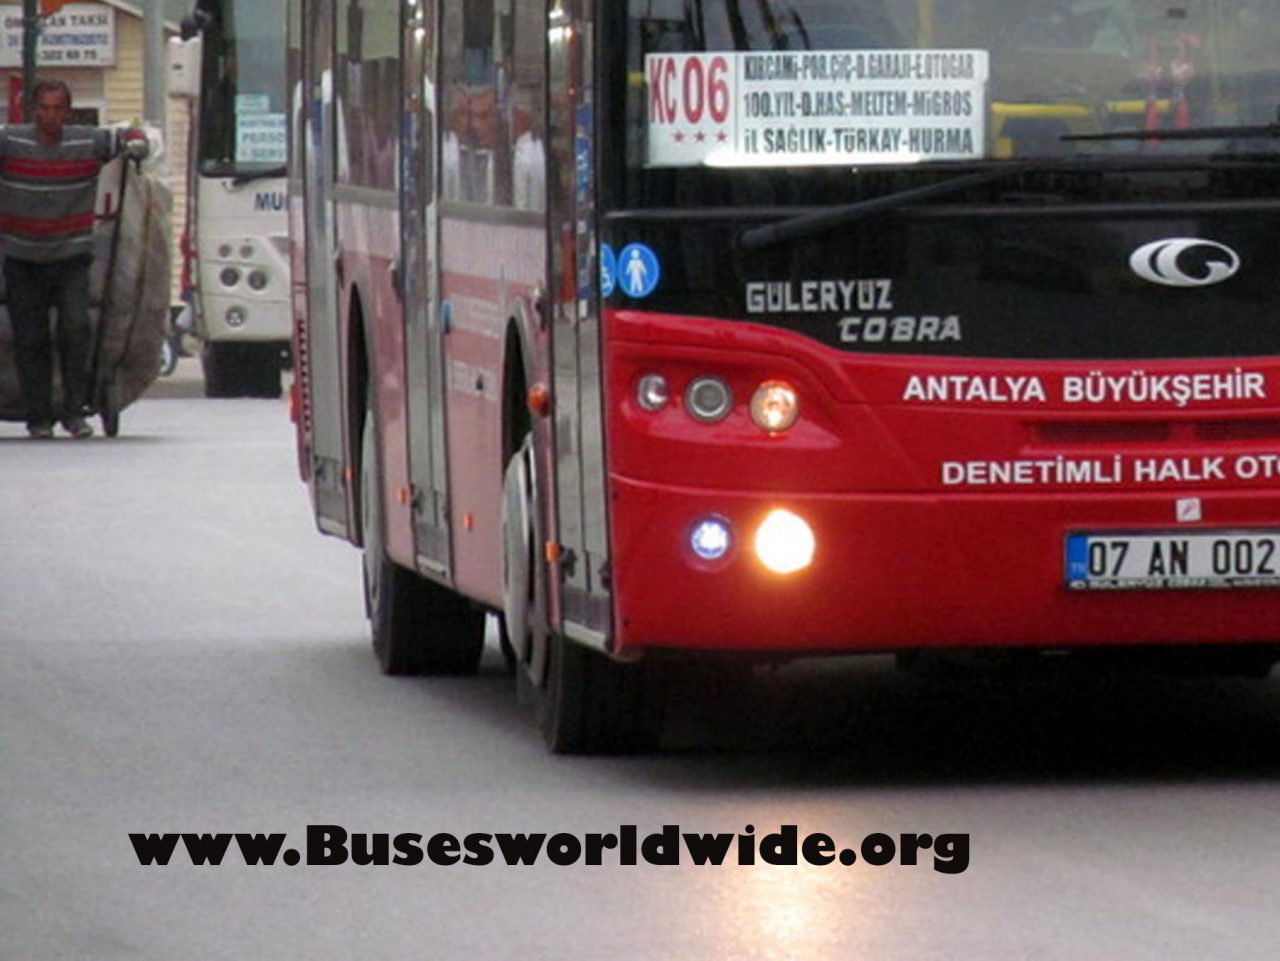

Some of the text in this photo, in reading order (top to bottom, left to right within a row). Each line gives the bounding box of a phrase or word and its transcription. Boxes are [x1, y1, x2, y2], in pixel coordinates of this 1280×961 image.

[839, 316, 962, 342] COBRA
[903, 376, 1046, 403] ANTALYA
[1063, 367, 1266, 407] BÜYÜKŞEHİR
[942, 454, 1122, 485] DENETİMLİ
[1134, 455, 1225, 482] HALK
[1088, 541, 1130, 577] 07
[1147, 540, 1189, 576] AN
